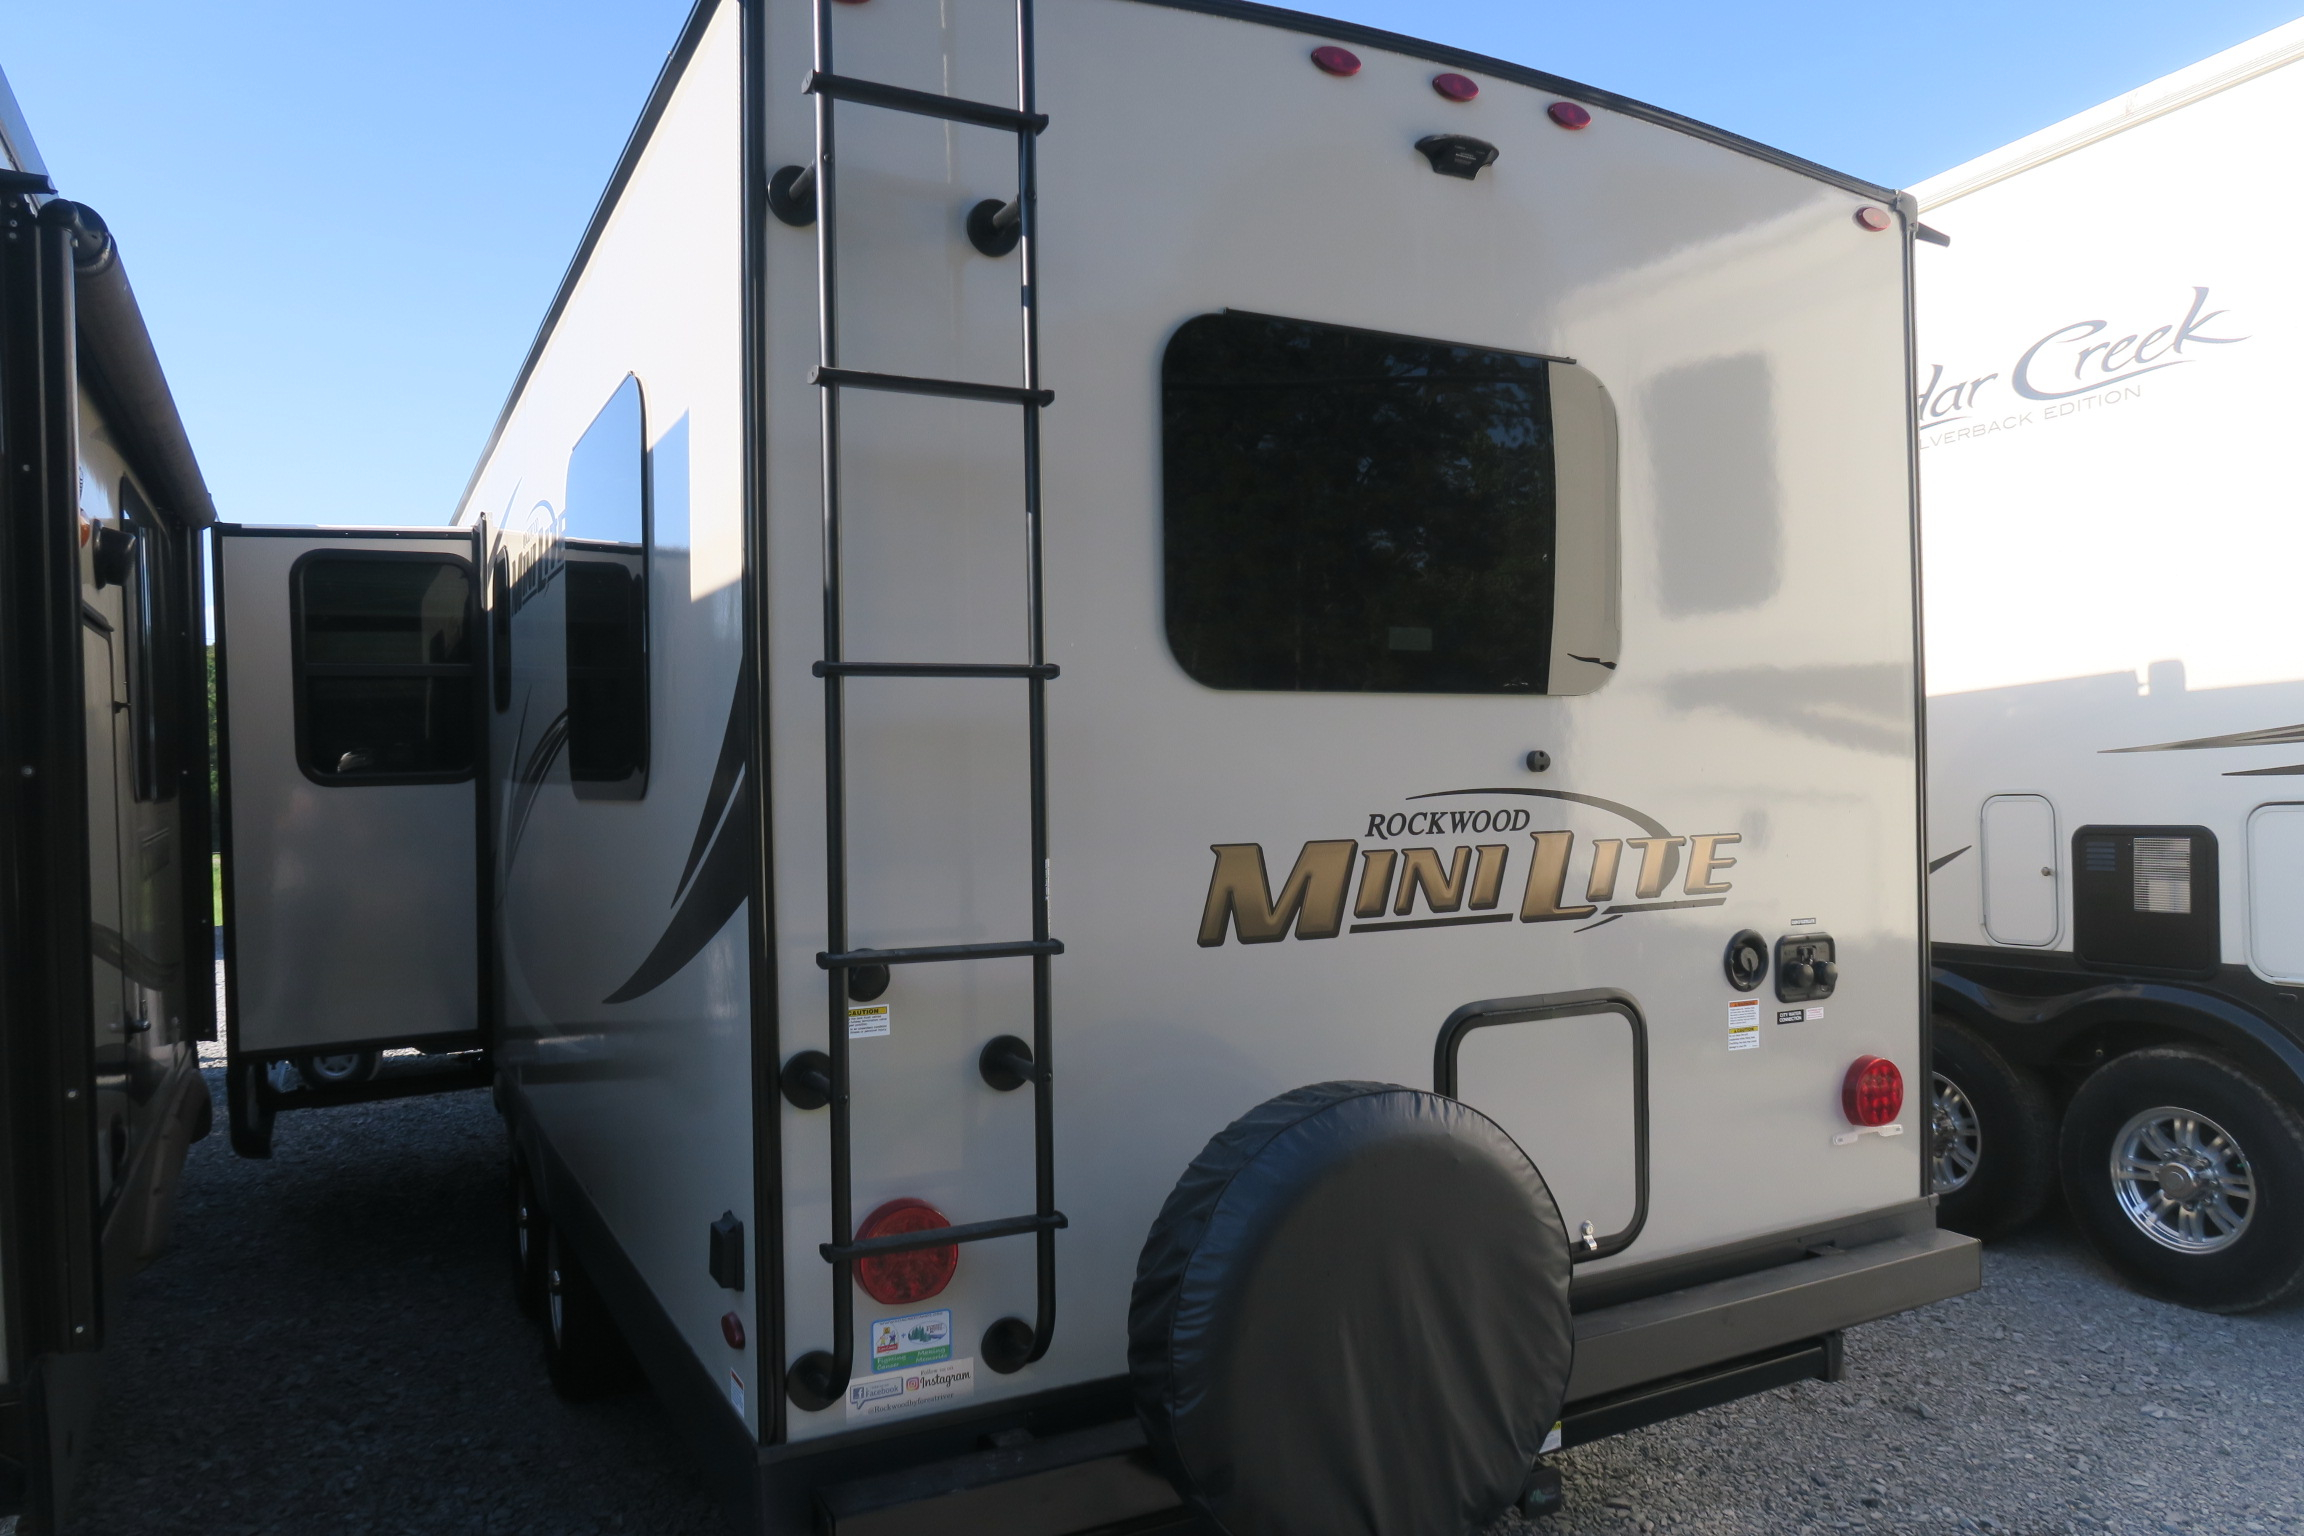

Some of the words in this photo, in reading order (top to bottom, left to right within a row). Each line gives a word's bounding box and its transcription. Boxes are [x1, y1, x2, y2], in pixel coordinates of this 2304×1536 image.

[1918, 364, 1998, 421] dar
[2012, 286, 2252, 400] Creek
[1919, 412, 2033, 450] LVERBACK
[2044, 385, 2141, 420] EDITION
[1365, 809, 1530, 839] ROCKWOOD
[1197, 839, 1509, 947] MINI
[1520, 830, 1742, 923] LITE
[848, 1008, 879, 1016] CAUTION
[877, 1355, 906, 1364] Fighting
[865, 1385, 899, 1398] Facebook
[920, 1370, 971, 1389] Instagram
